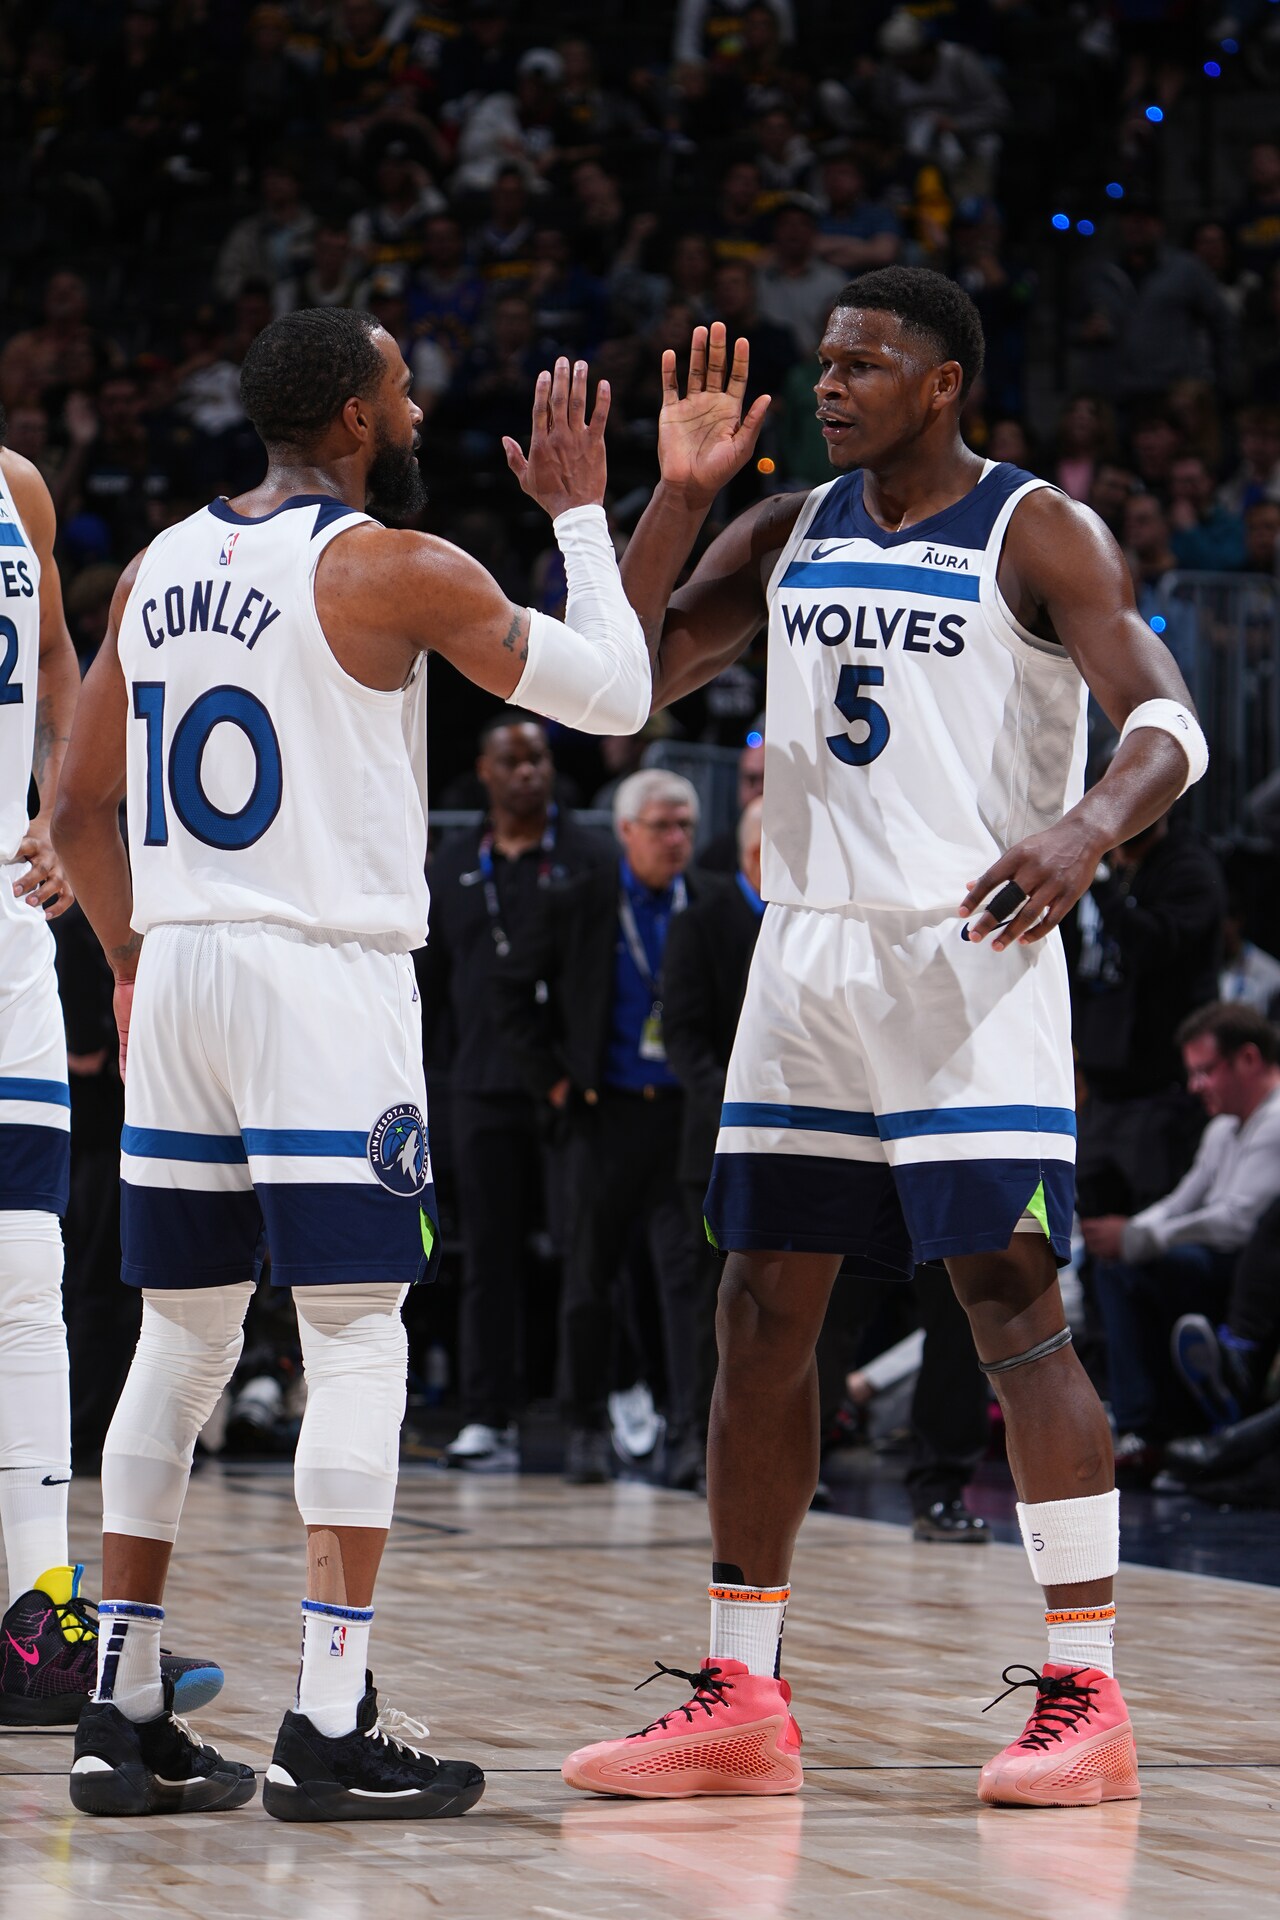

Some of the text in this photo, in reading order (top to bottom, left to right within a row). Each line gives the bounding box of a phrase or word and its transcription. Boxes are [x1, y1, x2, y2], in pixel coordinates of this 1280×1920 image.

[141, 580, 281, 650] CONLEY
[782, 604, 967, 657] WOLVES
[826, 664, 891, 766] 5
[132, 681, 283, 851] 10
[372, 1107, 404, 1162] MINNESOTA
[317, 1555, 329, 1567] KT
[1032, 1532, 1045, 1552] 5
